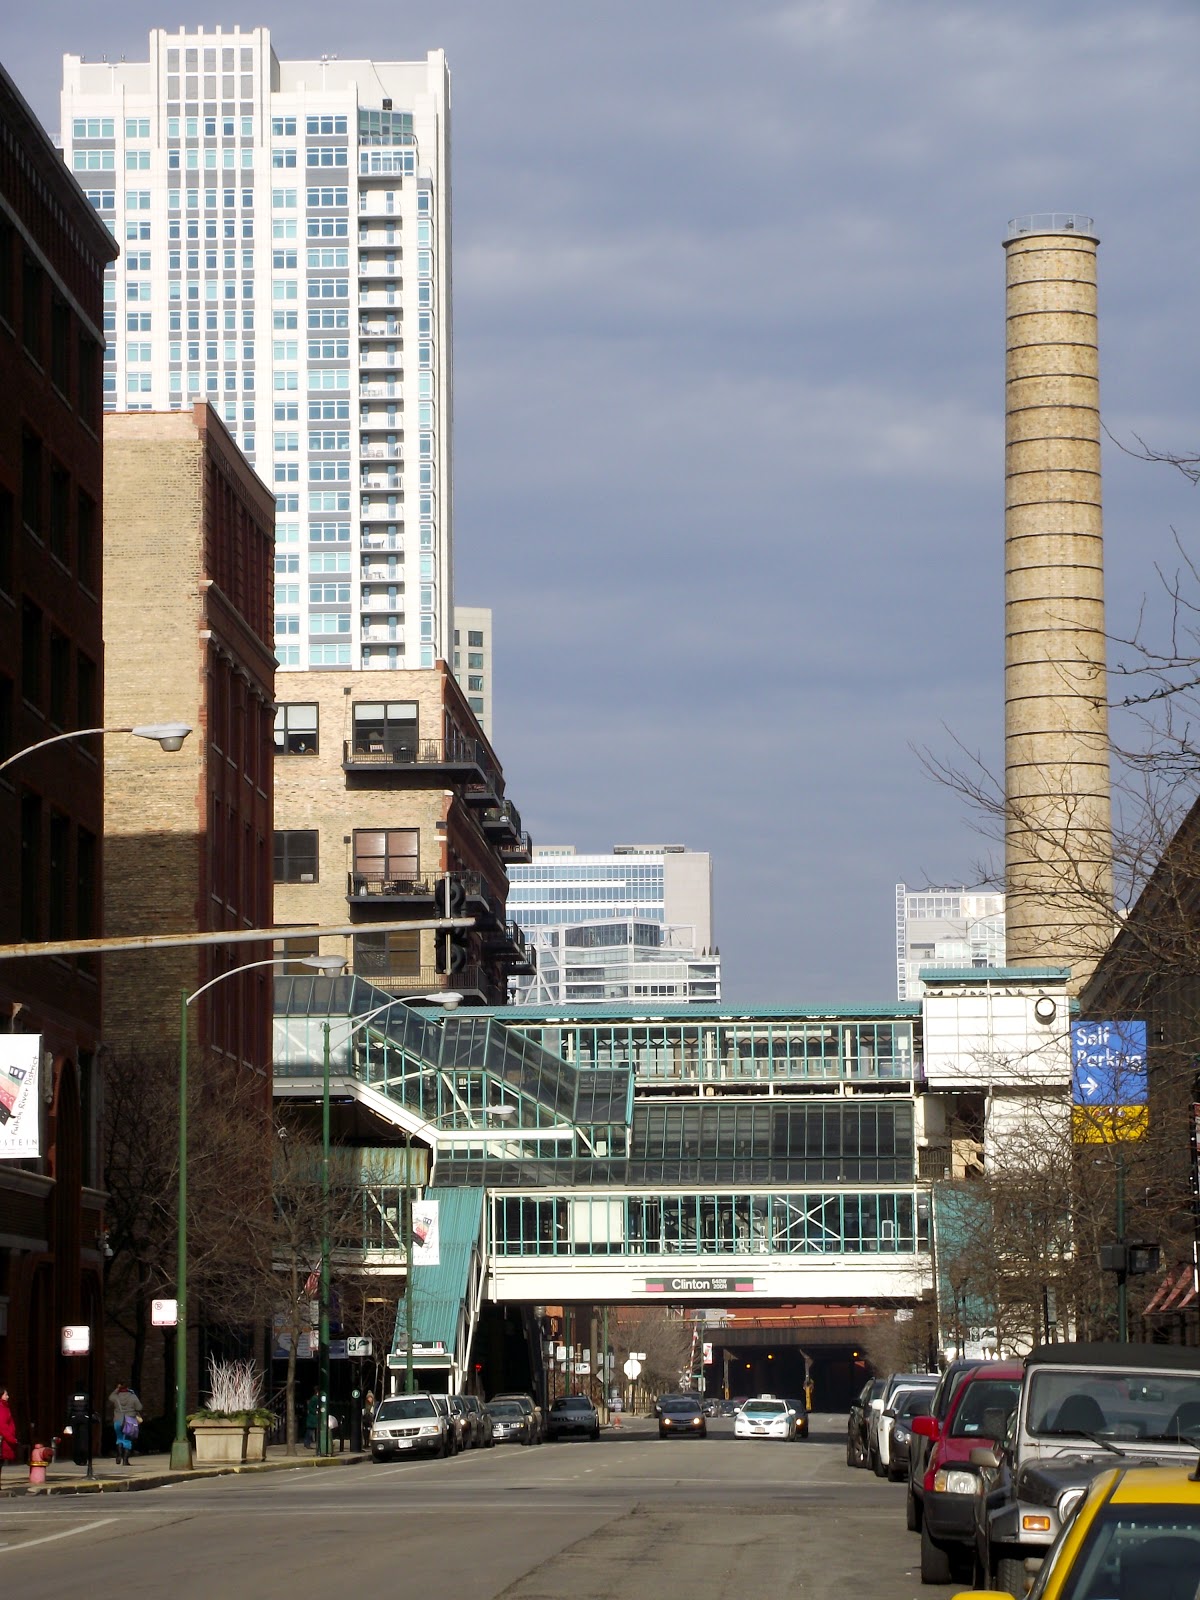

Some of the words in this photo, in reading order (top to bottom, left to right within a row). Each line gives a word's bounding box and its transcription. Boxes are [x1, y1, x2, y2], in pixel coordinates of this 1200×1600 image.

[1076, 1026, 1110, 1046] Self
[1076, 1048, 1142, 1072] Parking
[11, 1111, 23, 1136] Fulton
[18, 1088, 29, 1109] River
[24, 1055, 38, 1086] District
[0, 1138, 38, 1146] STEIN
[671, 1278, 711, 1290] Clinton
